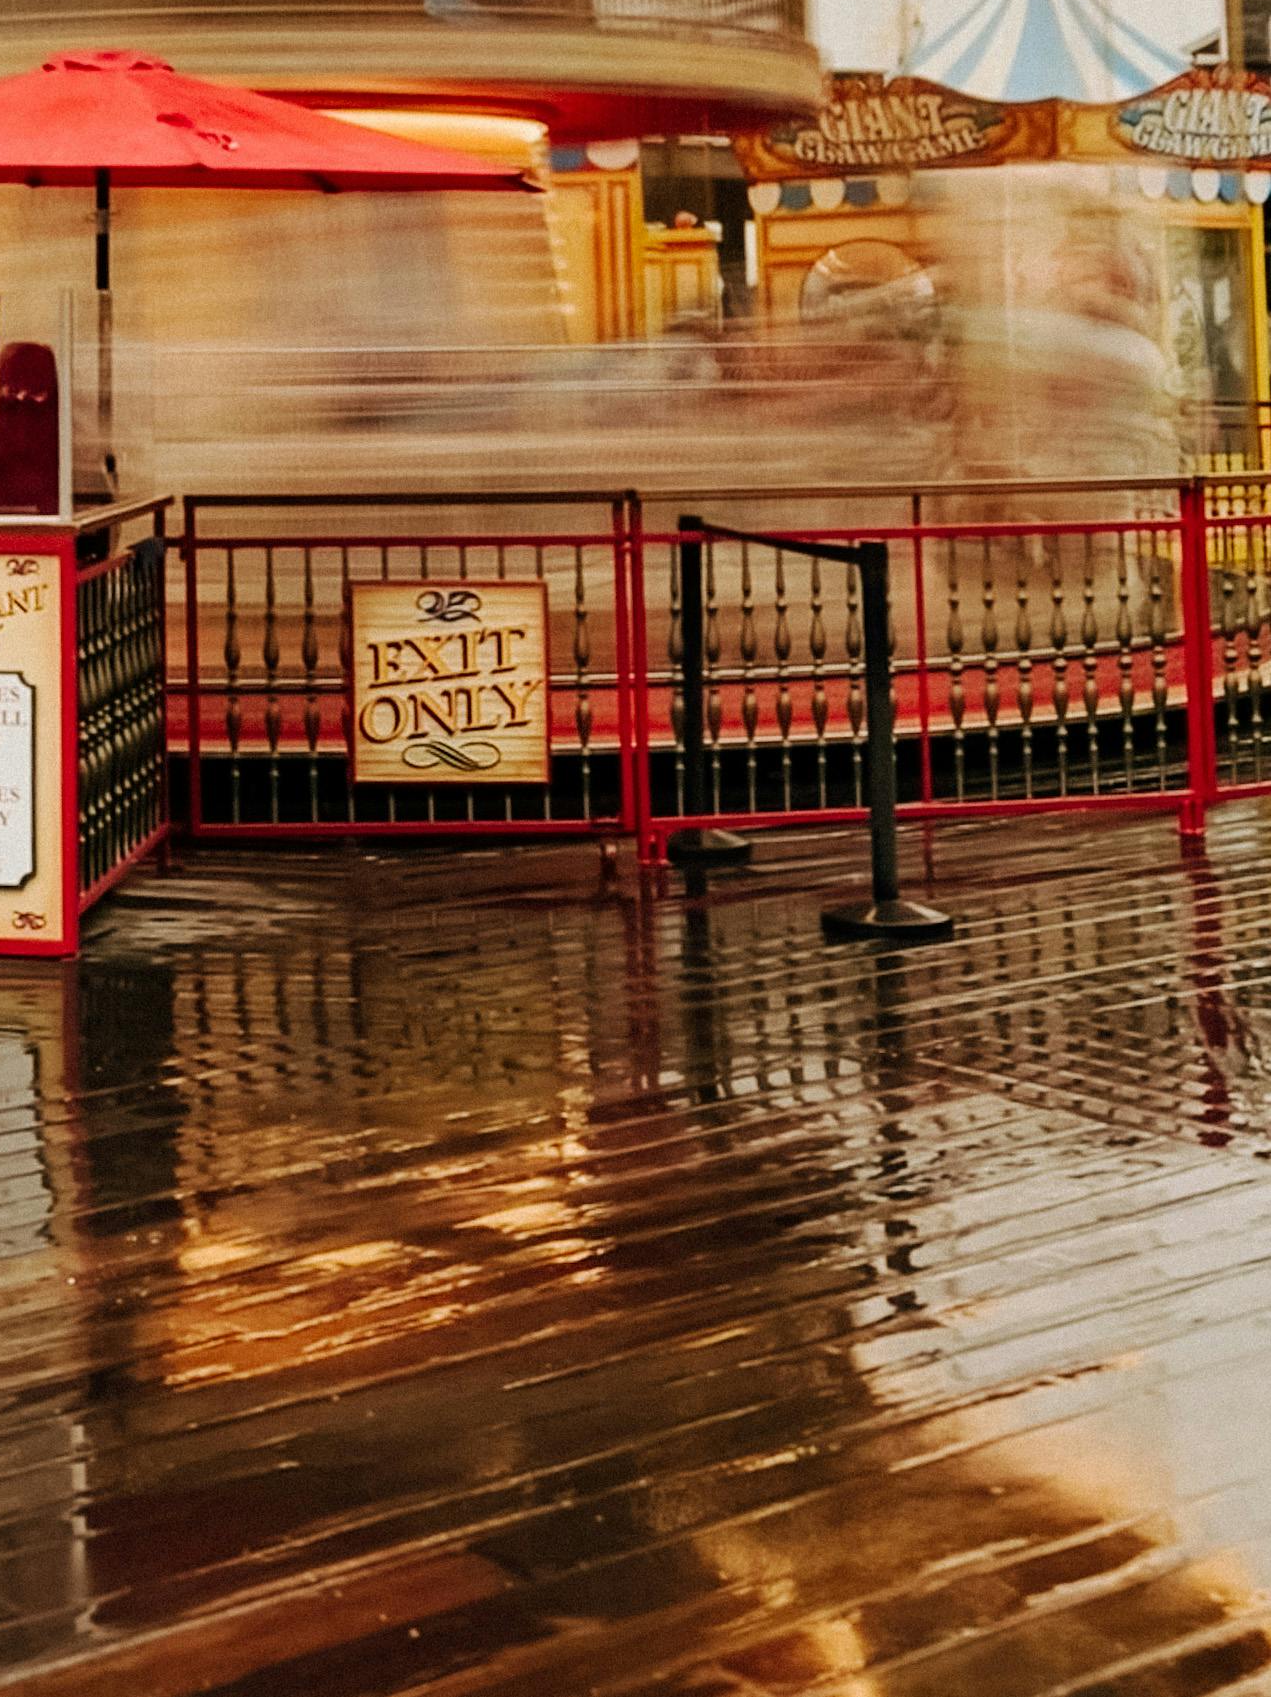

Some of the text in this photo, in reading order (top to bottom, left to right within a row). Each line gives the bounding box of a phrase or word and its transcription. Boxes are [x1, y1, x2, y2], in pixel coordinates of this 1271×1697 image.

[818, 93, 945, 143] GIANT
[1162, 88, 1270, 135] GIANT
[367, 628, 527, 690] EXIT
[358, 679, 545, 745] ONLY
